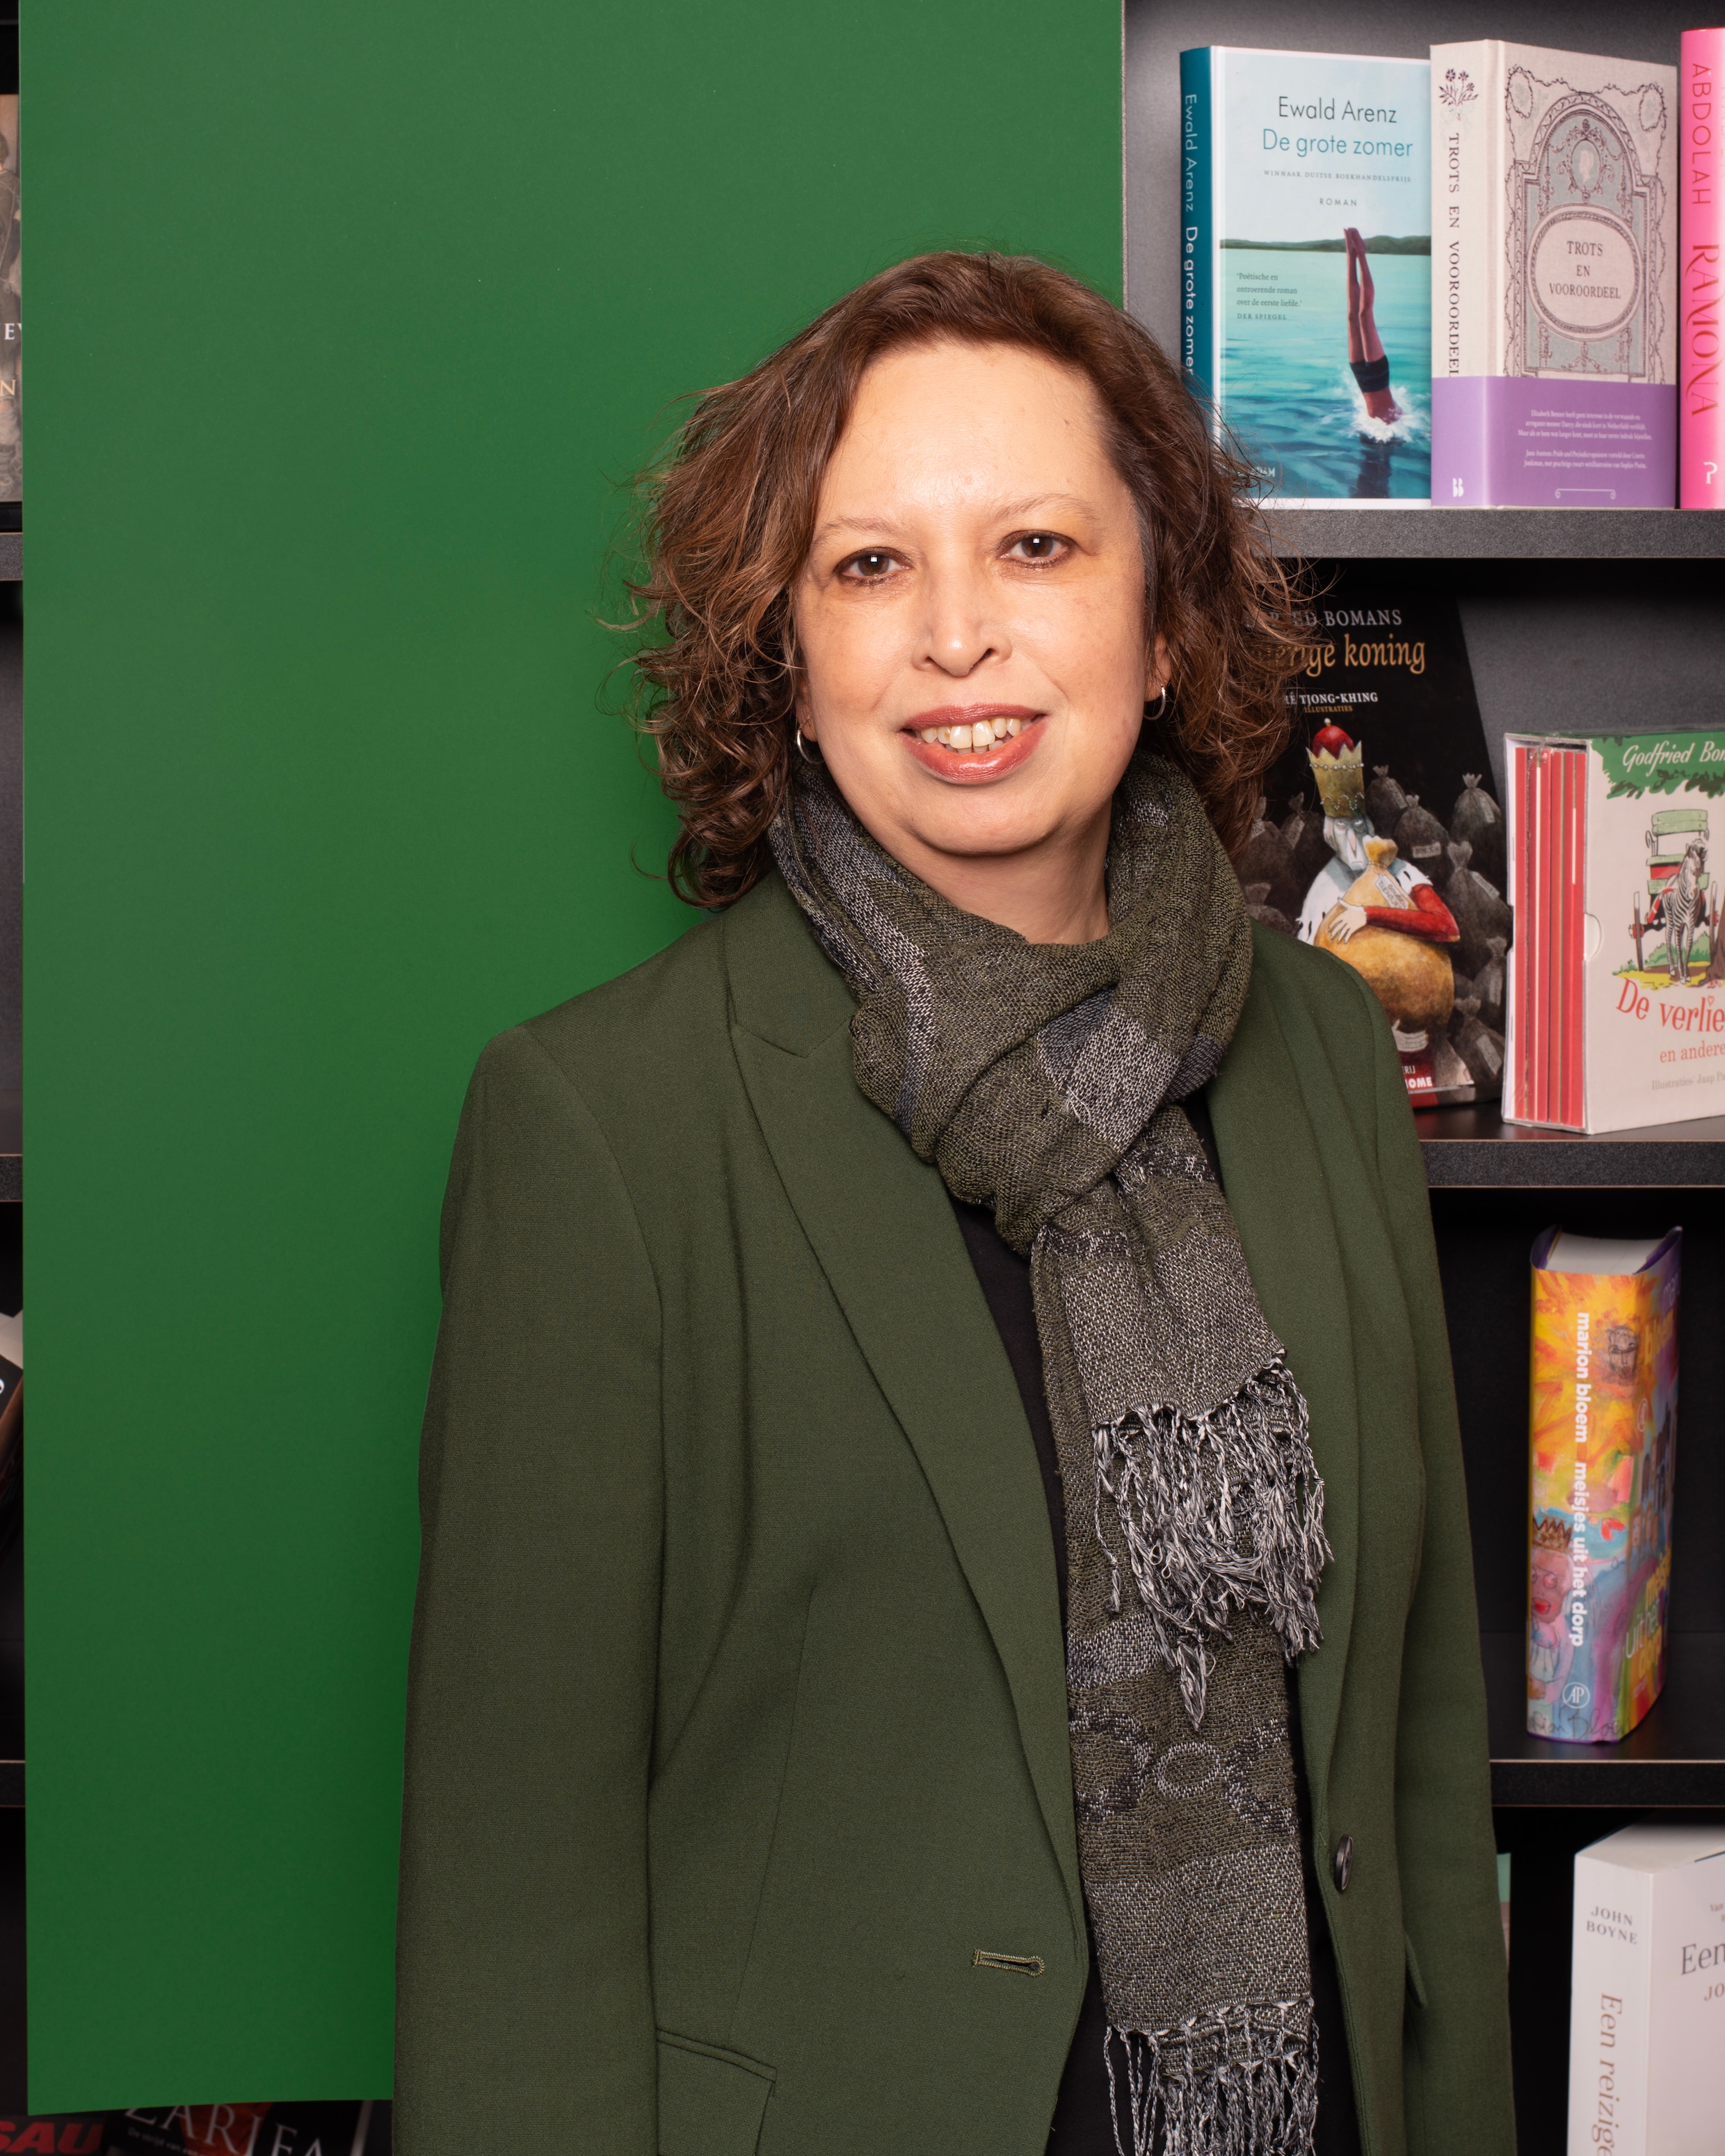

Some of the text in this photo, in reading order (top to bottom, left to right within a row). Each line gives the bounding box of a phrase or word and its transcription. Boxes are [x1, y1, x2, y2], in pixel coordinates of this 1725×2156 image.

[1185, 93, 1198, 150] Ewald
[1278, 96, 1397, 123] Ewald Arenz
[1262, 128, 1413, 158] De grote zomer
[1185, 156, 1198, 213] Arenz
[1335, 173, 1411, 183] BOEKHANDELSPRIJS
[1319, 198, 1358, 207] ROMAN
[1185, 227, 1198, 255] De
[1566, 241, 1603, 257] TROTS
[1685, 63, 1725, 417] ABDOLAH RAMONA
[1448, 132, 1460, 378] TROTS EN VOOROORDEEL
[1576, 264, 1591, 277] EN
[1183, 259, 1197, 310] grote
[1549, 282, 1621, 299] VOOROORDEEL
[1324, 609, 1402, 626] BOMANS
[1344, 633, 1426, 675] koning
[1299, 692, 1379, 707] TJONG-KHING
[1303, 705, 1353, 714] ILLUSTRATIES
[1622, 740, 1696, 778] Godfried
[1615, 976, 1650, 1020] De
[1660, 1049, 1676, 1063] en
[1696, 1073, 1715, 1085] Jaap
[1569, 1312, 1591, 1648] marion bloem meisjes uit het dorp
[1591, 1906, 1634, 1926] JOHN
[1586, 1920, 1638, 1945] BOYNE
[1600, 1993, 1623, 2048] Een
